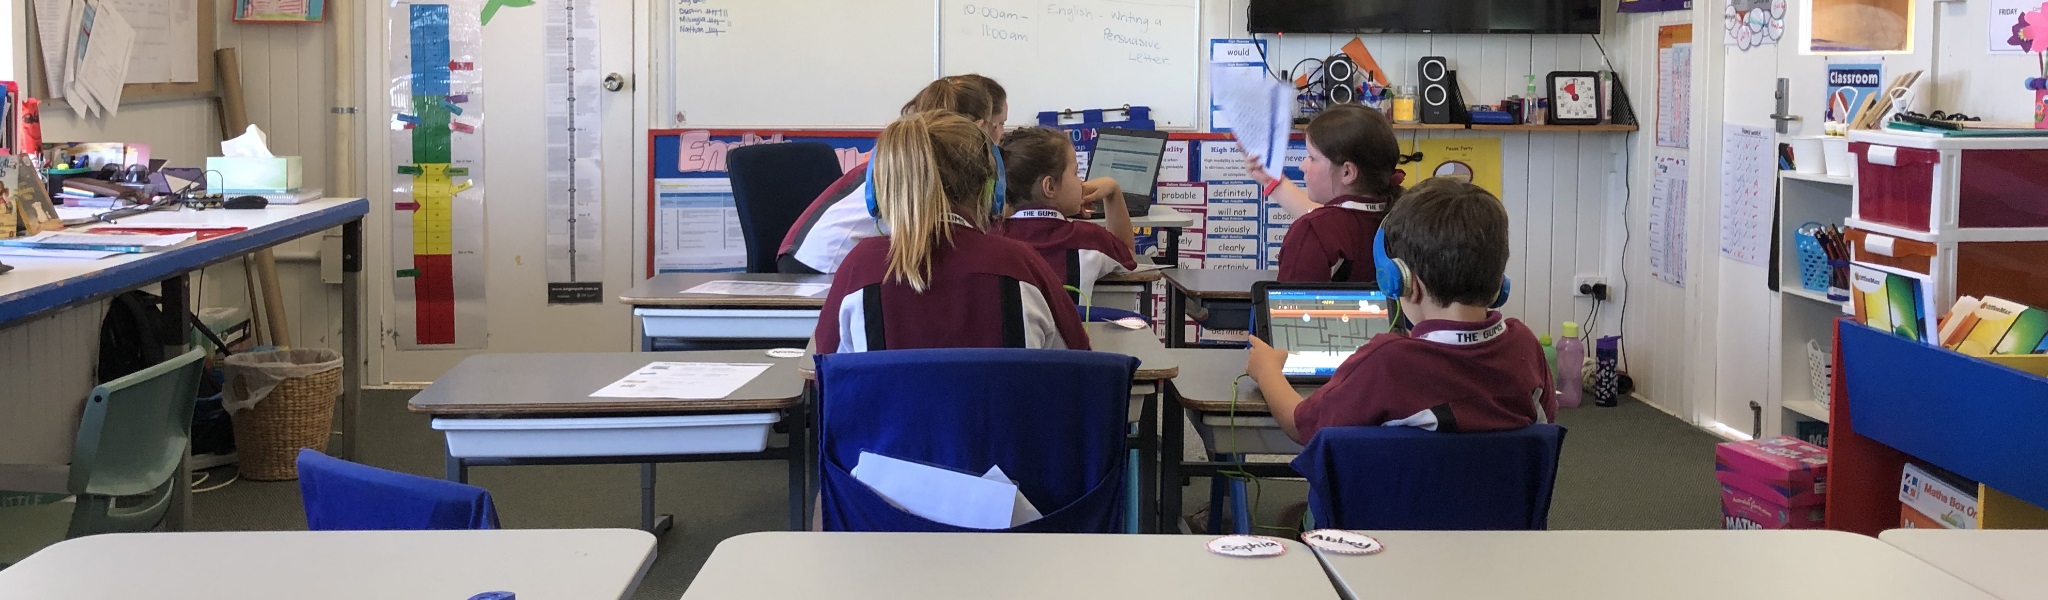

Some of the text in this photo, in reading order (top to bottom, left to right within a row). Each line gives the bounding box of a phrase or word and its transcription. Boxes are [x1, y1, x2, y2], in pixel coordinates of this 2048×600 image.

[1998, 8, 2018, 16] FRIDAY
[1047, 3, 1093, 22] English
[1112, 10, 1149, 33] Writing
[1103, 27, 1161, 50] Persuasive
[1227, 48, 1250, 56] would
[1830, 71, 1878, 85] Classroom
[1211, 145, 1228, 155] High
[1161, 191, 1197, 201] probable
[1213, 188, 1253, 199] definitely
[1037, 210, 1058, 218] GUMS
[1233, 208, 1248, 216] not
[1213, 225, 1251, 235] obviously
[1218, 243, 1246, 254] clearly
[1858, 275, 1880, 285] OfficeMax
[1985, 303, 2012, 316] OfficeMax
[1456, 321, 1504, 343] THE GUMS
[1923, 483, 1948, 504] Maths
[1949, 496, 1965, 513] Box
[1221, 541, 1278, 552] Sophia
[1310, 533, 1372, 549] Abbey
